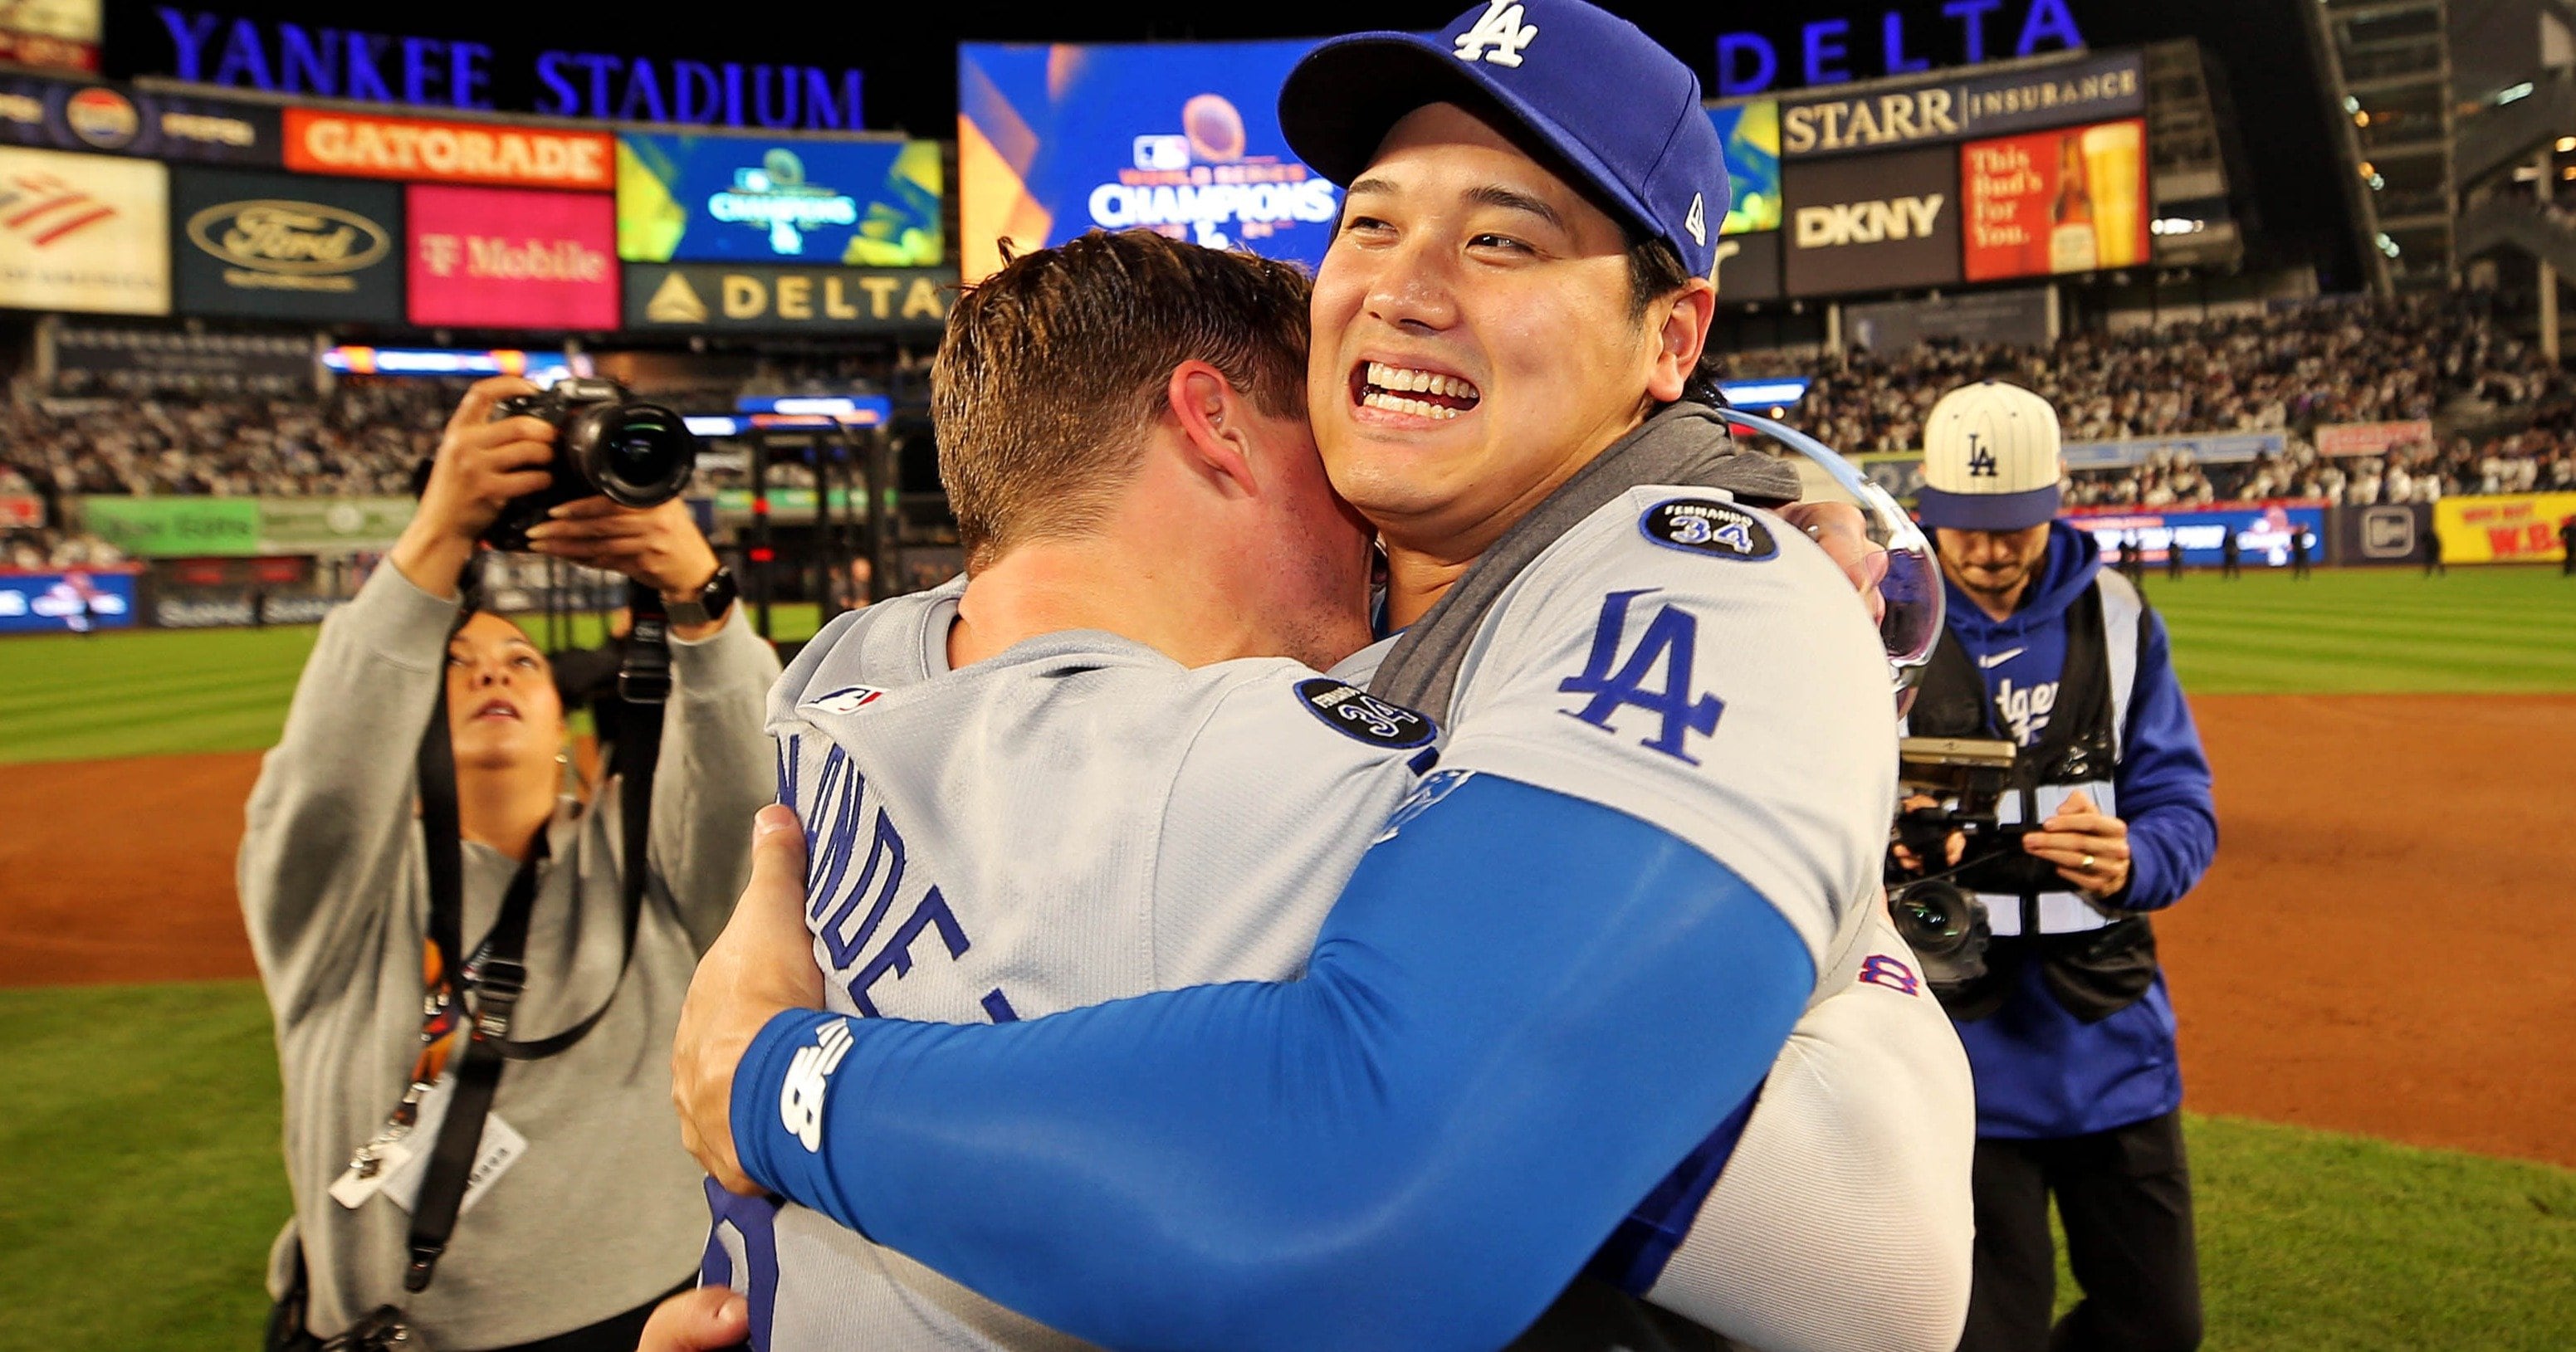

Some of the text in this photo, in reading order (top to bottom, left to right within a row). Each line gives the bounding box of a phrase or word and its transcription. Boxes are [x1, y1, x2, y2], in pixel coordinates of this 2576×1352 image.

[1451, 0, 1538, 68] LA
[1716, 0, 2085, 95] DELTA
[159, 6, 866, 131] YANKEE STADIUM
[1783, 69, 2138, 154] STARR INSURANCE
[305, 120, 605, 182] GATORADE
[1972, 144, 2030, 173] This
[1088, 178, 1337, 228] CHAMPIONS
[1795, 193, 1944, 248] DKNY
[222, 207, 357, 262] Ford
[467, 236, 606, 284] Mobile
[722, 274, 946, 320] DELTA
[1967, 433, 1999, 477] LA
[1664, 504, 1754, 528] FERNANDO
[1669, 515, 1754, 554] 34
[1557, 587, 1727, 767] LA
[1337, 695, 1420, 738] 34
[776, 734, 1019, 1024] NANDE
